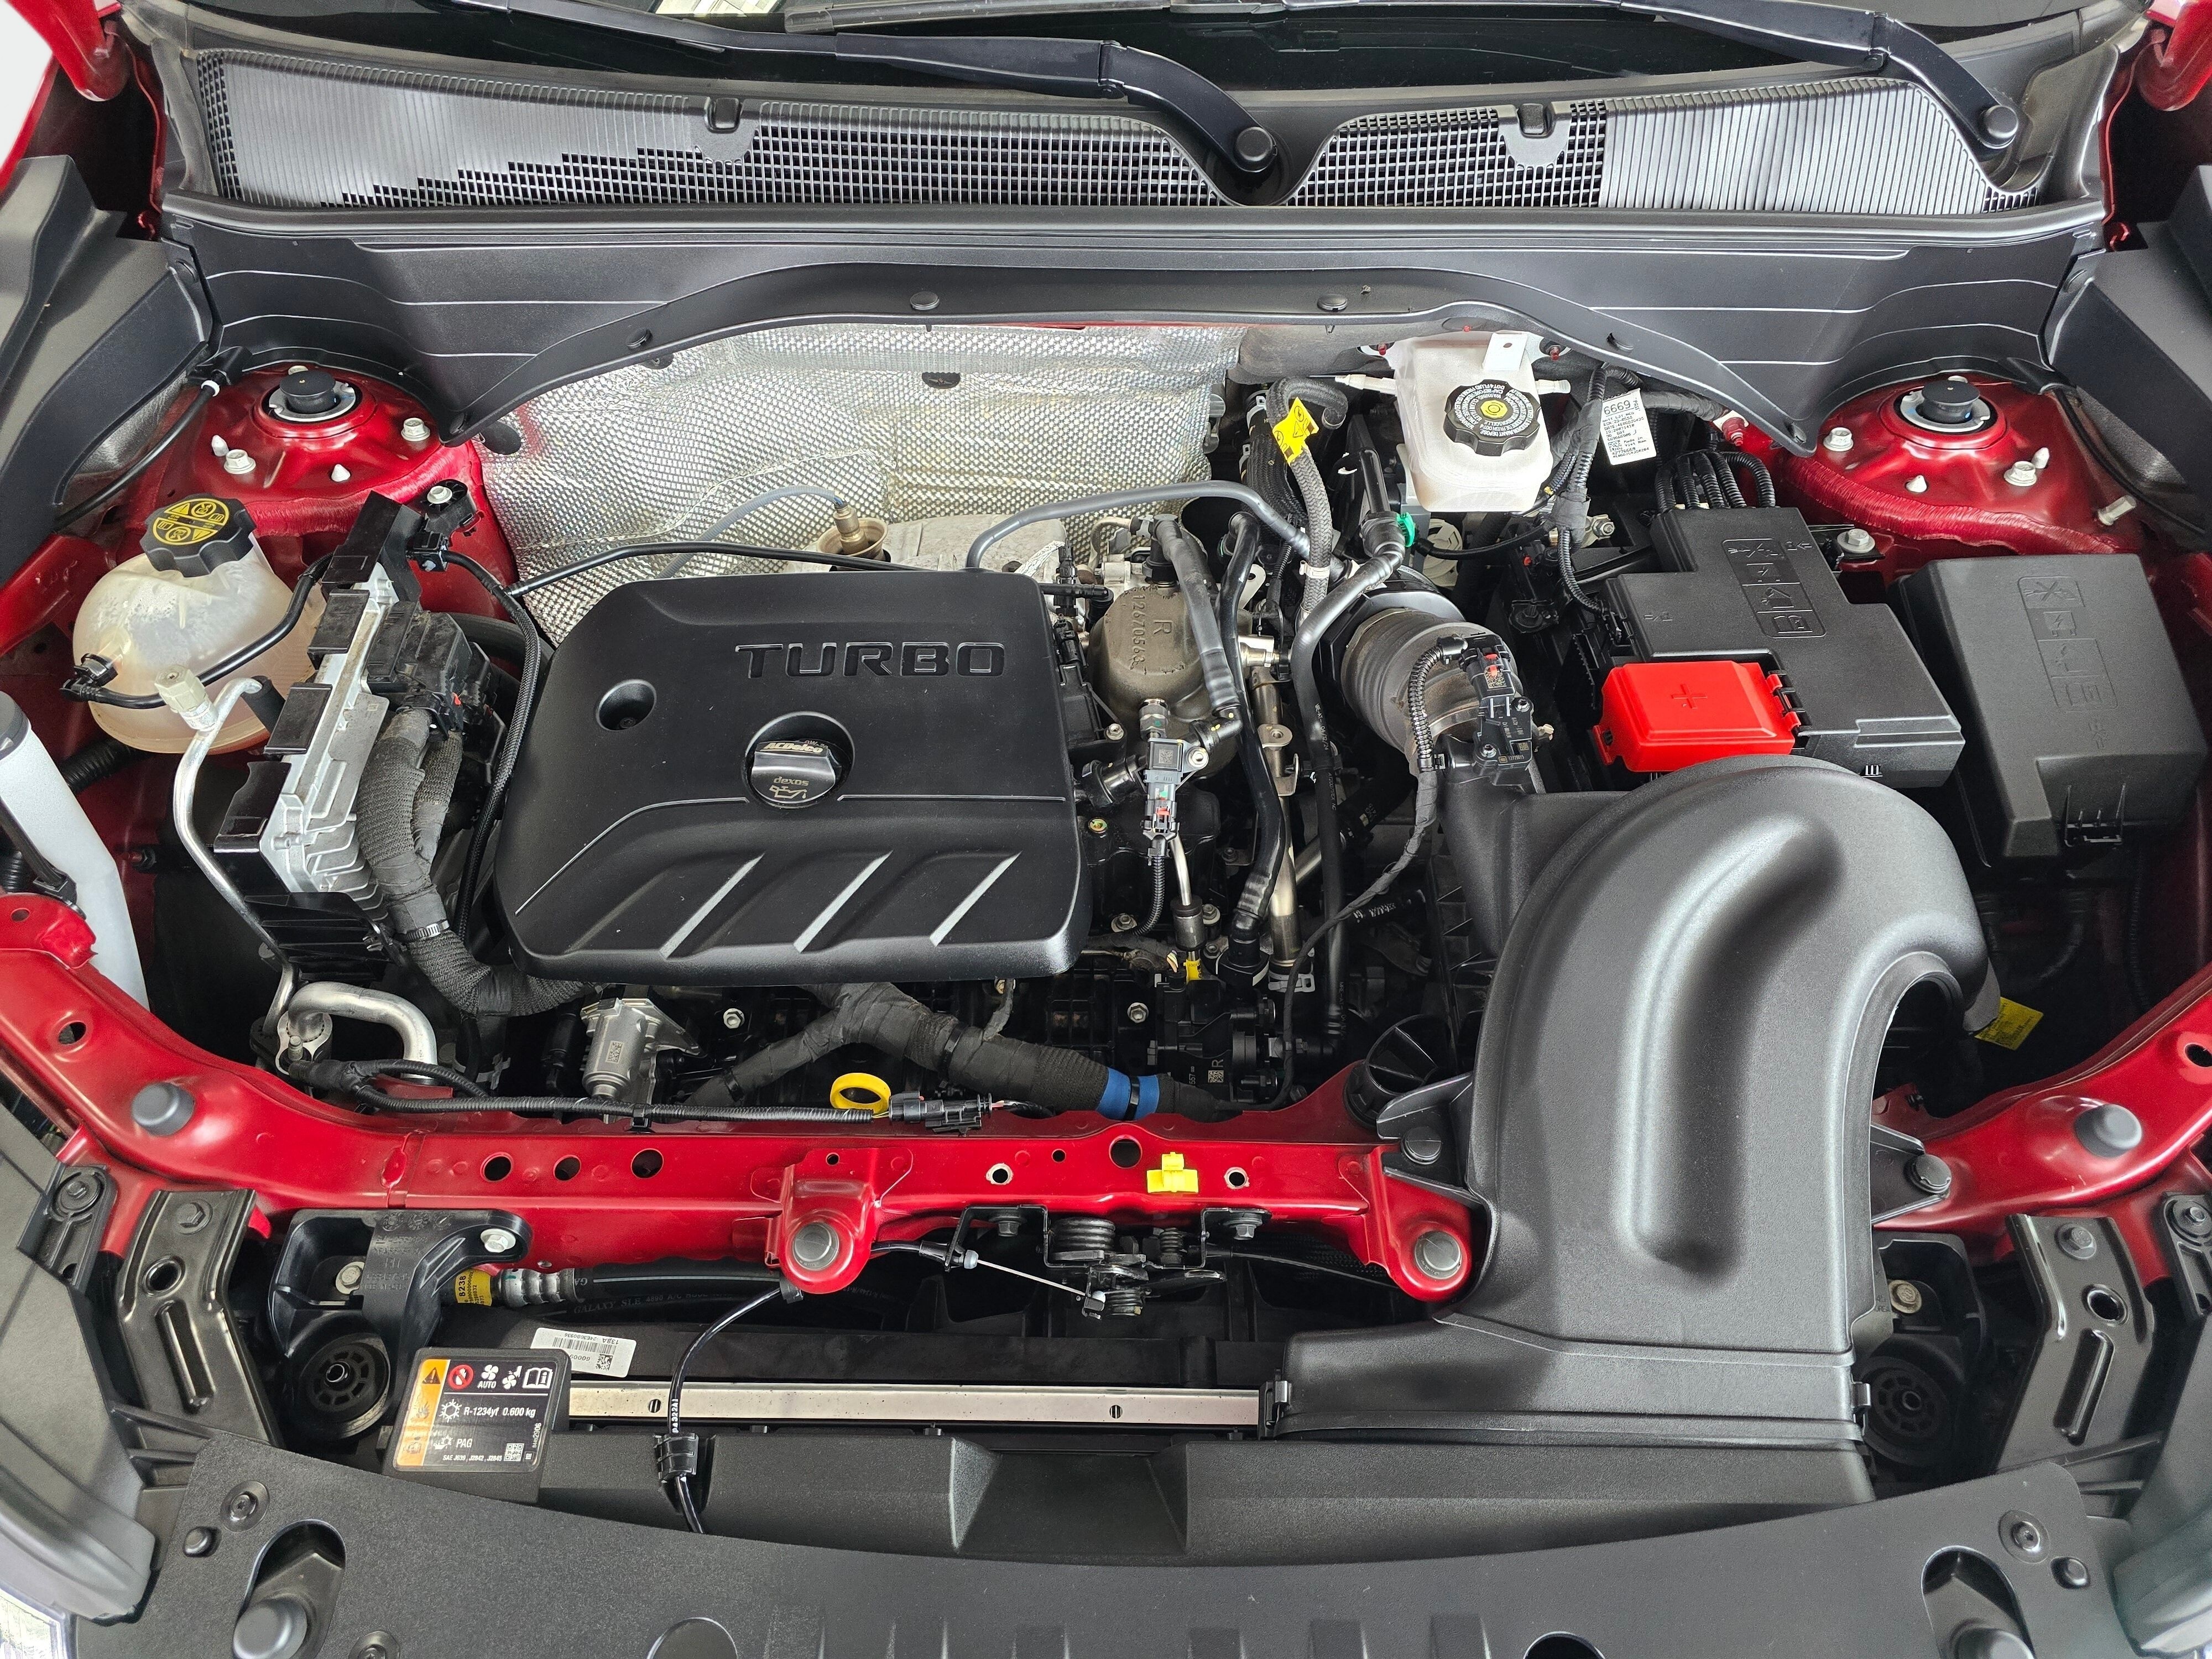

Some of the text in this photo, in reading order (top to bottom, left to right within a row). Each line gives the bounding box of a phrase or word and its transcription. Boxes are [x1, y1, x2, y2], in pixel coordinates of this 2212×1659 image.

[1604, 400, 1630, 415] 6669
[1154, 620, 1173, 634] R
[735, 642, 1005, 678] TURBO
[763, 742, 823, 753] ACDelco
[773, 776, 810, 786] dexos
[1212, 1059, 1224, 1068] R
[458, 1275, 467, 1297] 8238
[573, 1301, 616, 1314] GALAXY
[620, 1298, 641, 1307] SLE
[477, 1380, 497, 1389] AUTO
[463, 1406, 536, 1418] R-1234yf 0.600 kg
[456, 1438, 473, 1448] PAG
